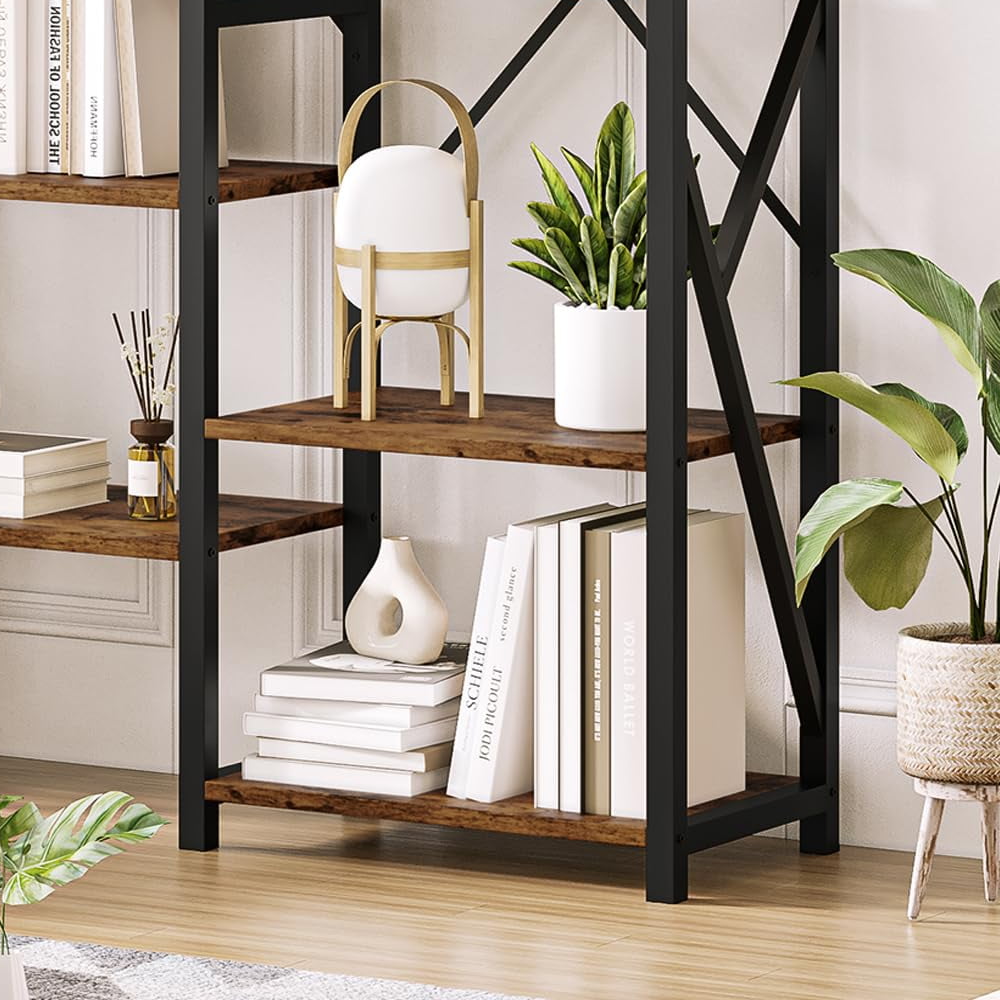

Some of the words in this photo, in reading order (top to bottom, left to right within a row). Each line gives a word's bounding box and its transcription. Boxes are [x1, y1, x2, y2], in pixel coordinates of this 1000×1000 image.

[504, 566, 518, 602] glance
[498, 604, 511, 642] second
[623, 620, 636, 676] WORLD
[465, 635, 489, 711] SCHIELE
[485, 665, 504, 726] PICOULT
[623, 682, 636, 736] BALLET
[478, 729, 493, 762] JODI
